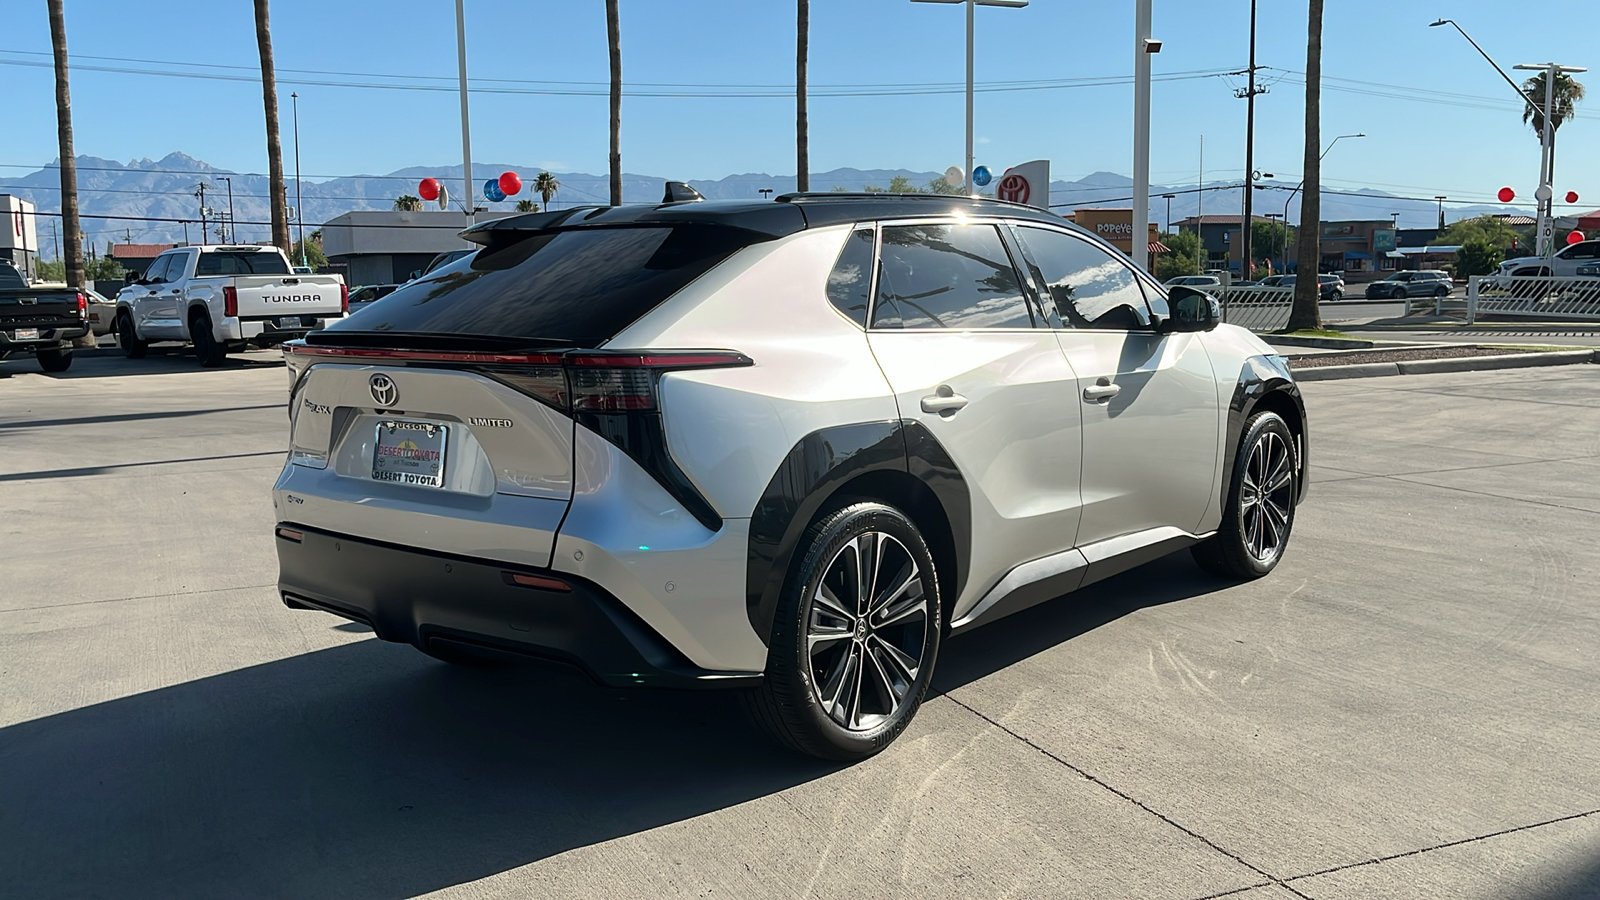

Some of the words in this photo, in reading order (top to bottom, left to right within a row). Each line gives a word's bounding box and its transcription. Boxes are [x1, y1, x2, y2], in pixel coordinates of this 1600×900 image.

[1097, 223, 1133, 234] POPeYe
[261, 294, 321, 303] TUNDRA
[394, 423, 427, 431] TUCSON
[468, 417, 513, 428] LIMITED
[379, 446, 407, 457] DESERT
[410, 448, 440, 461] TOYOTA
[375, 471, 402, 480] DESERT
[405, 474, 437, 486] TOYOTA
